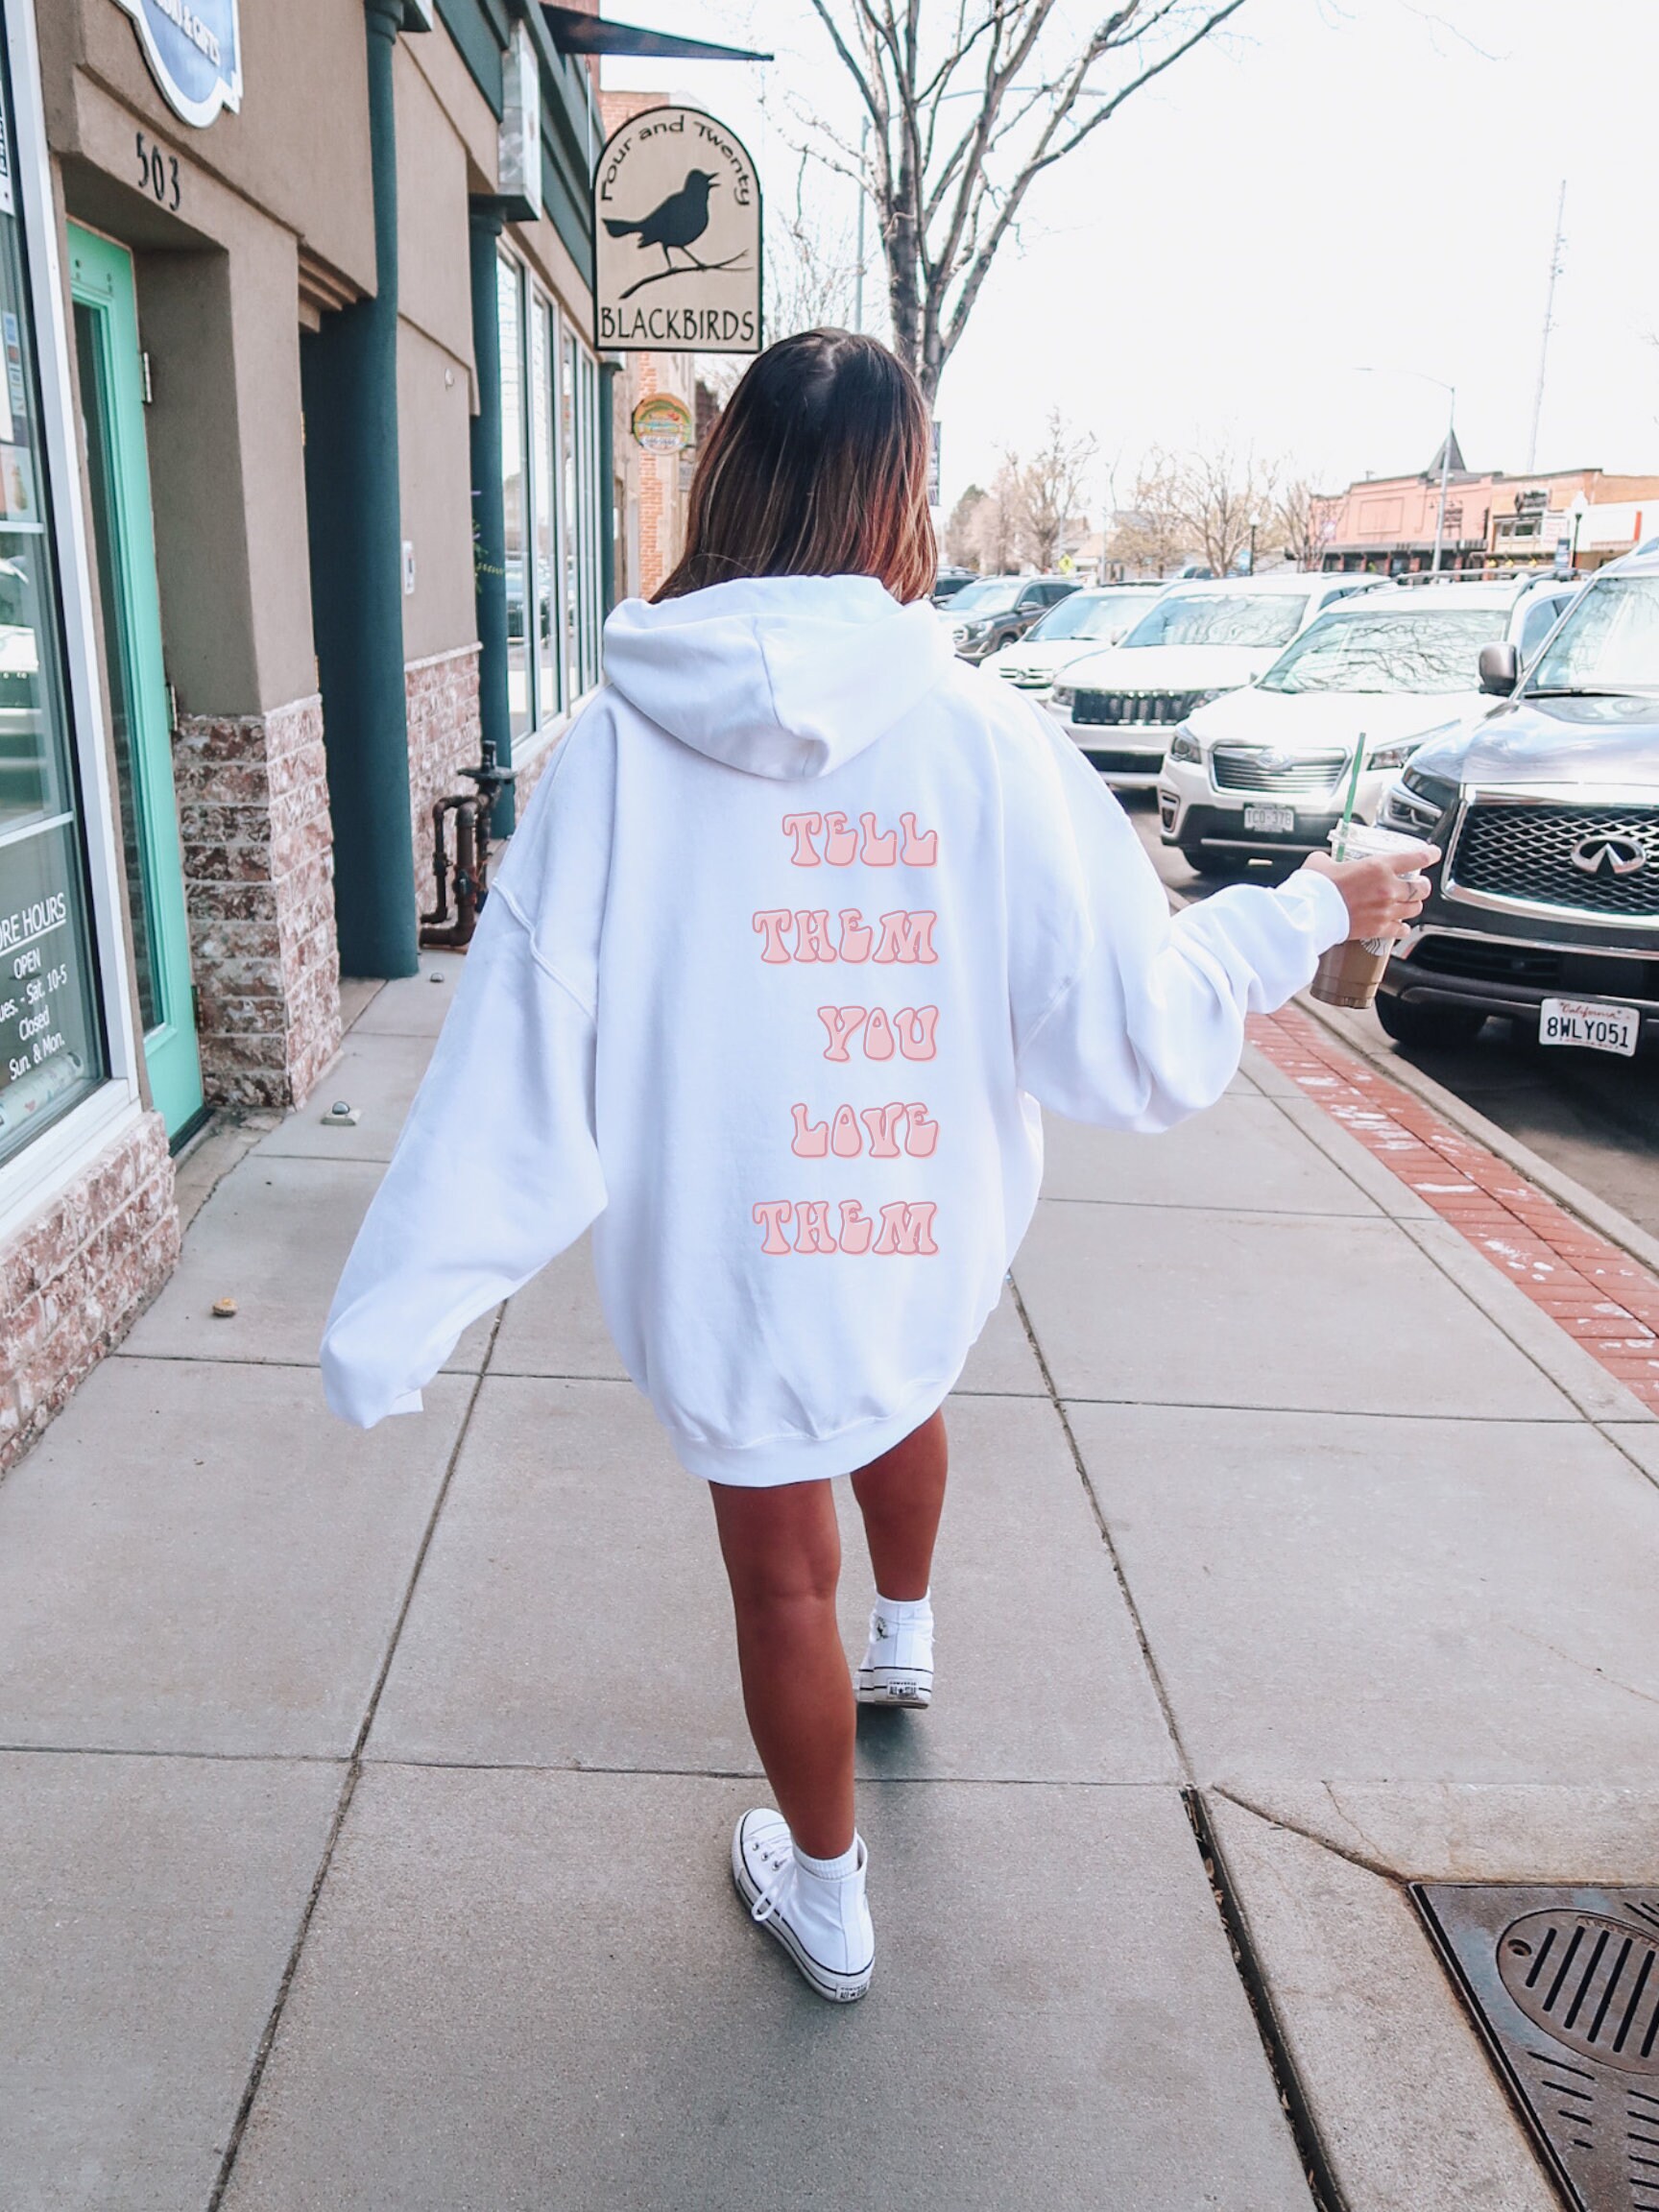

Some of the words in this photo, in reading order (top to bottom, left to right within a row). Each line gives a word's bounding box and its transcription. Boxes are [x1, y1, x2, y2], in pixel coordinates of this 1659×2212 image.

[136, 132, 180, 211] 503
[638, 114, 685, 141] and
[693, 121, 751, 205] Twenty
[600, 306, 755, 342] BLACKBIRDS
[781, 810, 938, 867] TELL
[22, 892, 66, 937] HOURS
[752, 907, 939, 965] THEM
[13, 947, 41, 979] OPEN
[47, 963, 67, 993] 10-5
[19, 1004, 50, 1042] Closed
[817, 1004, 939, 1062] YOU
[1547, 1016, 1629, 1048] 8WLY051
[9, 1055, 32, 1081] Sun.
[32, 1043, 43, 1065] &
[42, 1032, 65, 1057] Mon.
[790, 1102, 939, 1159] LOVE
[752, 1198, 939, 1256] THEM
